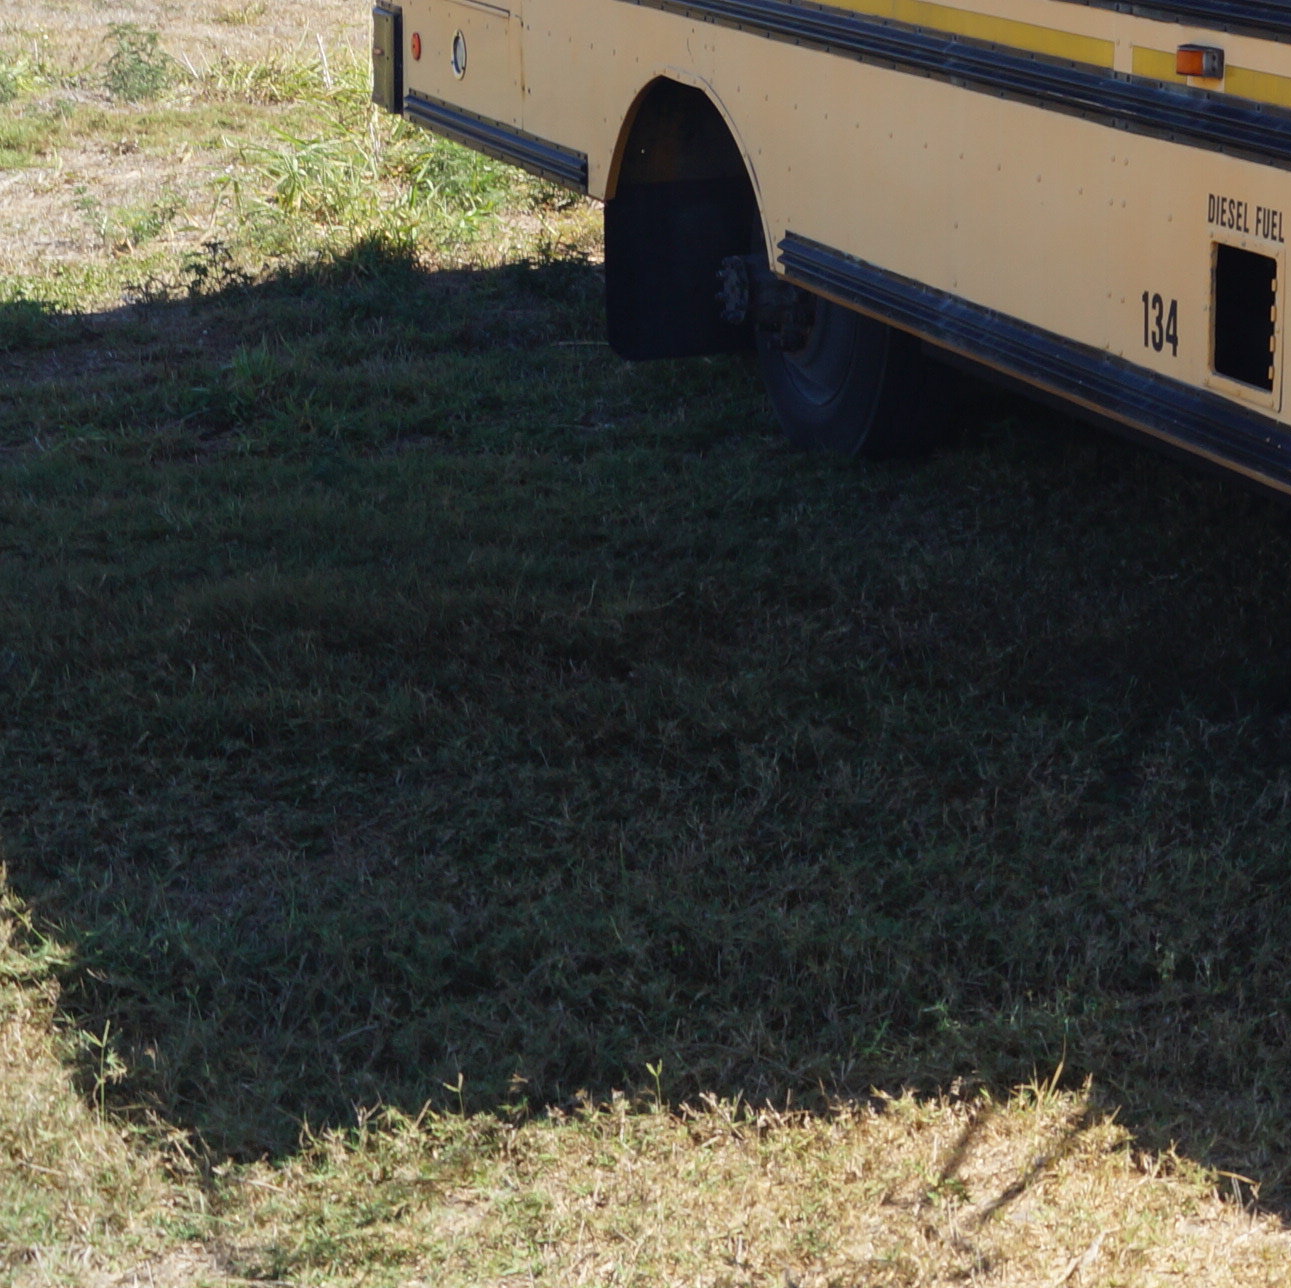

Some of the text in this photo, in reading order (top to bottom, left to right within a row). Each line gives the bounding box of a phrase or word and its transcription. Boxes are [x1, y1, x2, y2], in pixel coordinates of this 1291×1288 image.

[1207, 193, 1285, 244] DIESEL FUEL
[1141, 290, 1179, 358] 134
